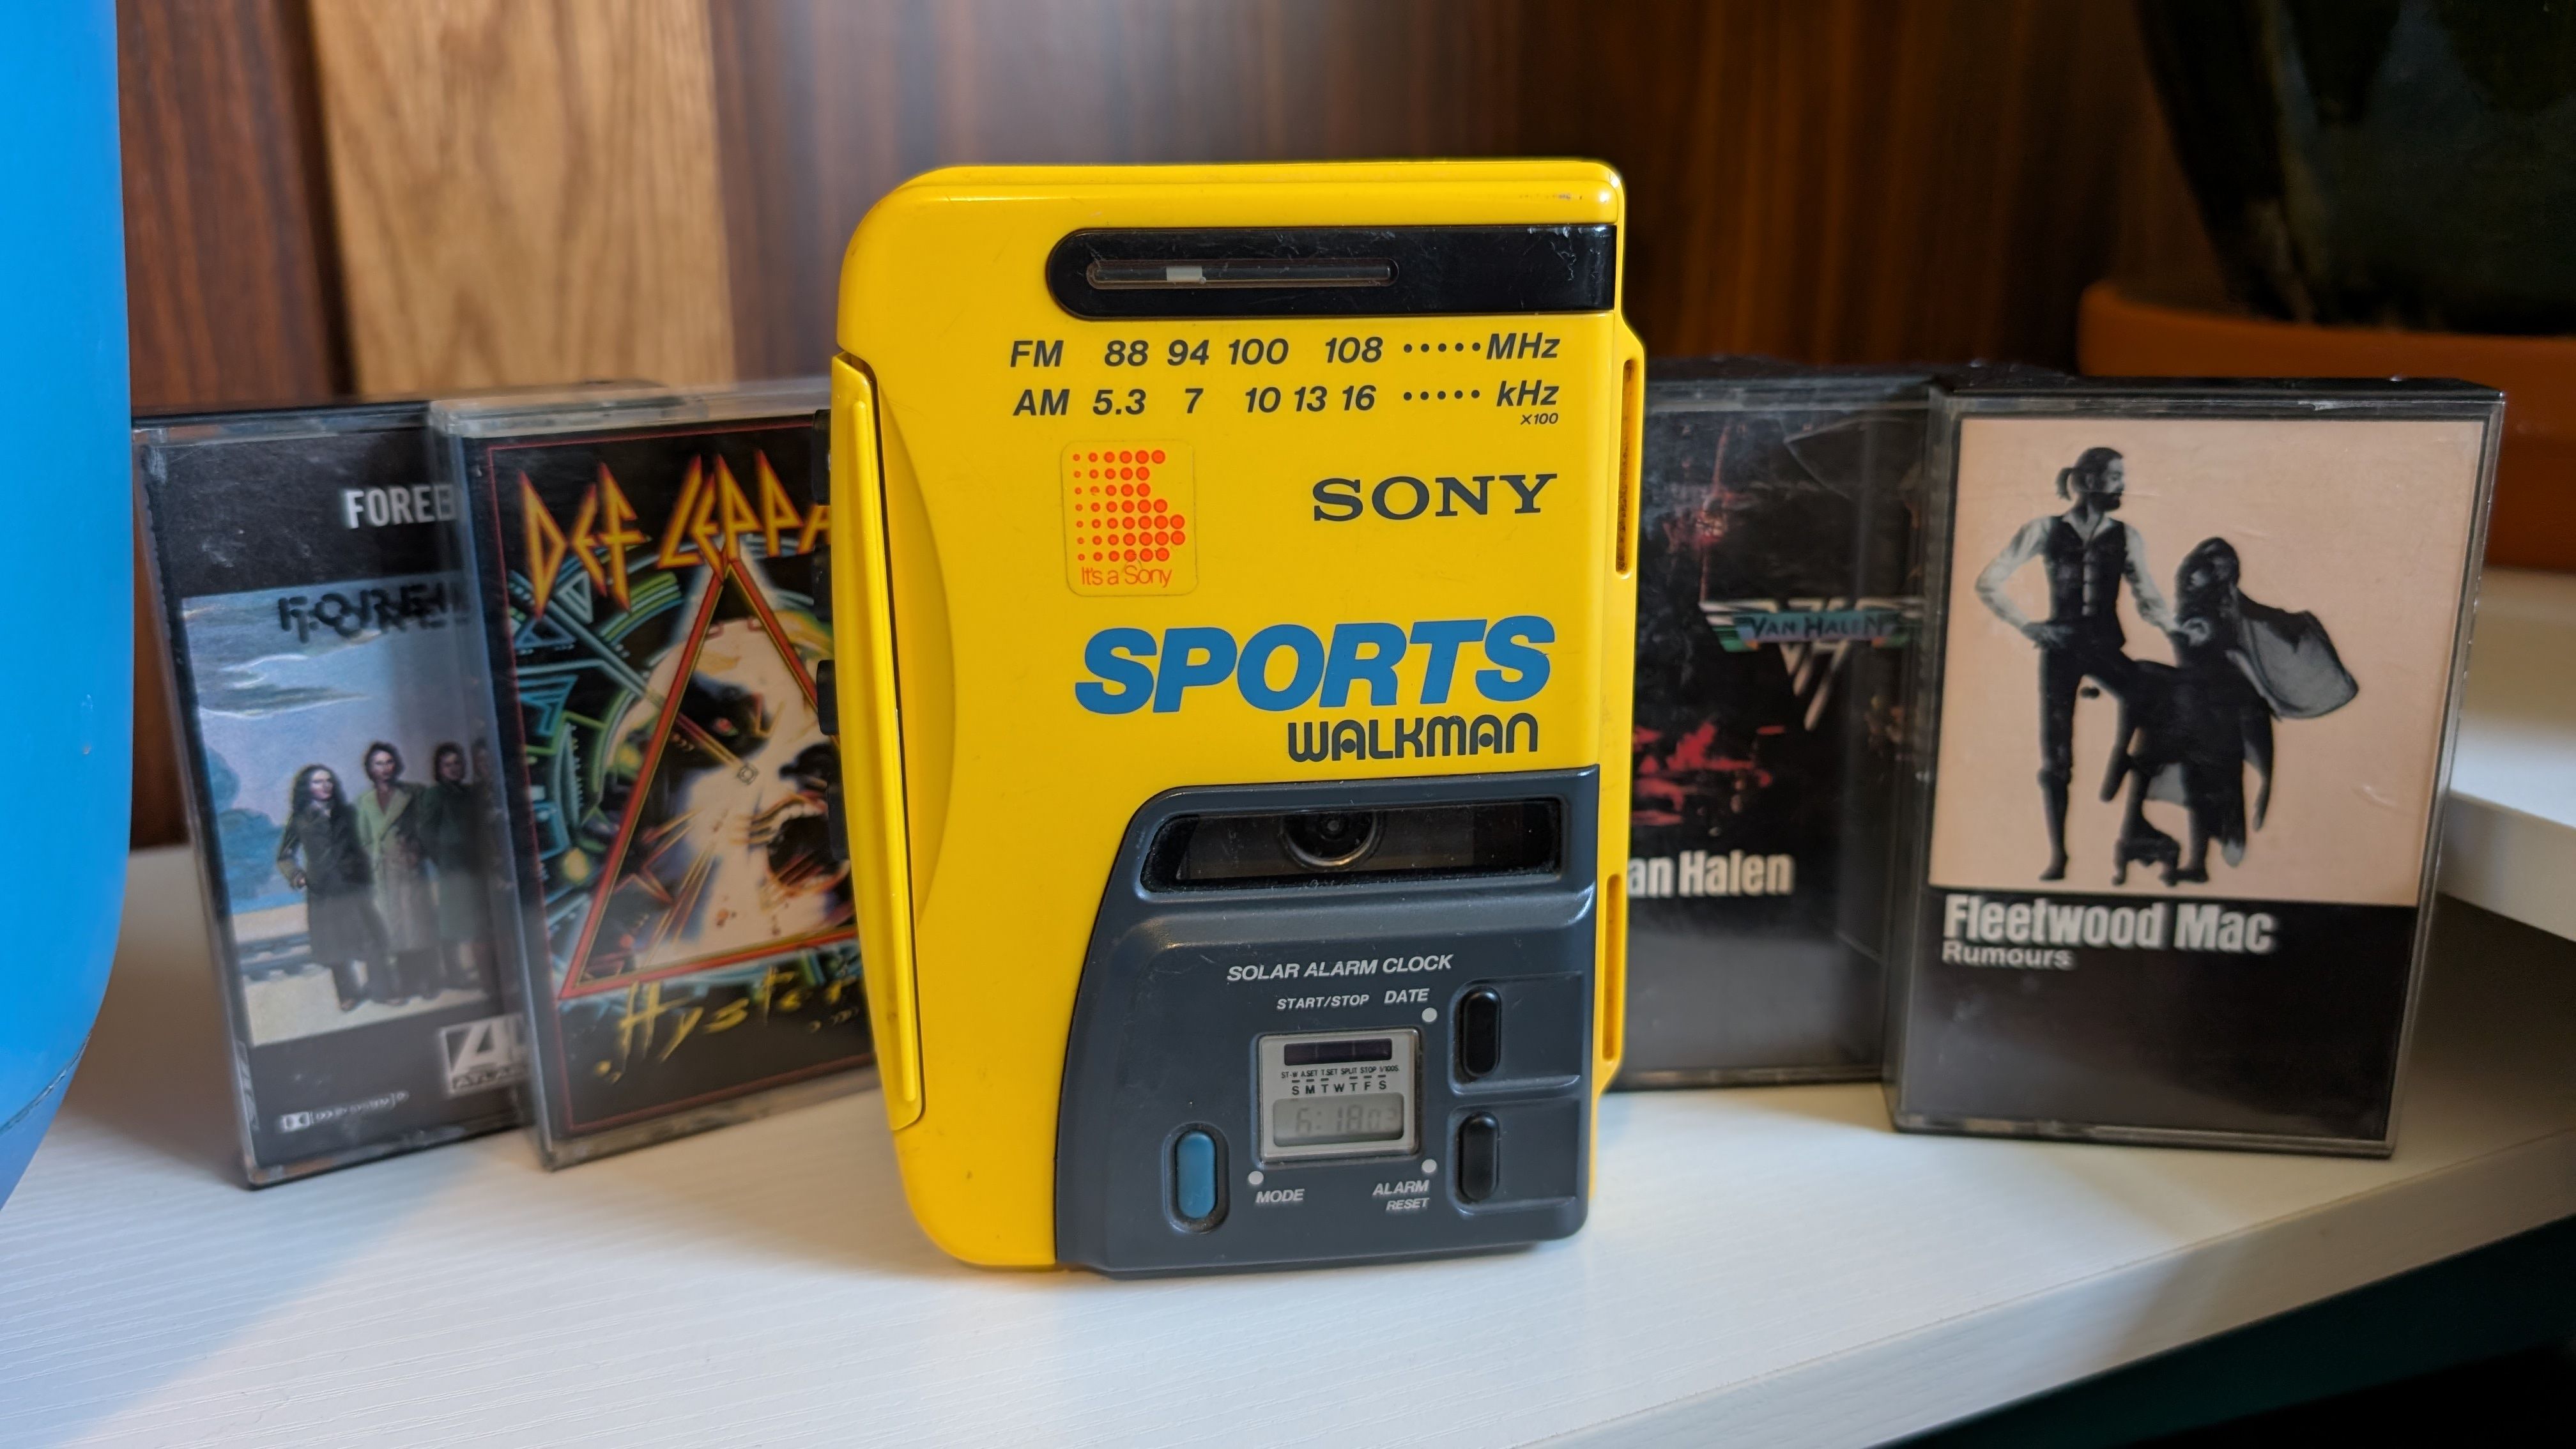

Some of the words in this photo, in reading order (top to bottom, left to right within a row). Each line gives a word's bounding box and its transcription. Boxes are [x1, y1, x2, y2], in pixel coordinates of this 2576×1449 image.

[1010, 340, 1064, 368] FM
[1104, 340, 1149, 367] 88
[1167, 339, 1210, 366] 94
[1229, 338, 1289, 365] 100
[1325, 336, 1384, 364] 108
[1486, 332, 1561, 360] MHz
[1013, 388, 1070, 416] AM
[1092, 388, 1147, 415] 5.3
[1184, 388, 1204, 414] 7
[1245, 386, 1282, 413] 10
[1294, 386, 1328, 412] 13
[1342, 385, 1377, 411] 16
[1496, 379, 1560, 407] kHz
[1312, 473, 1558, 522] SONY
[518, 461, 648, 620] DEF
[1082, 566, 1104, 585] It's
[1107, 569, 1119, 585] a
[1124, 564, 1173, 588] Sony
[1075, 615, 1556, 715] SPORTS
[1287, 712, 1539, 763] WALKMAN
[1678, 850, 1793, 896] Halen
[1942, 893, 2168, 949] Fleetwood
[2174, 902, 2280, 953] Mac
[1227, 963, 1300, 981] SOLAR
[1303, 959, 1378, 977] ALARM
[1383, 954, 1453, 973] CLOCK
[1942, 939, 2077, 970] Rumours
[1277, 994, 1370, 1009] START/STOP
[1384, 988, 1430, 1004] DATE
[1292, 1085, 1300, 1095] S
[1305, 1085, 1315, 1094] M
[1321, 1084, 1329, 1093] T
[1333, 1083, 1345, 1092] W
[1349, 1082, 1358, 1091] T
[1364, 1081, 1371, 1091] F
[1379, 1080, 1387, 1090] S
[1255, 1188, 1305, 1203] MODE
[1372, 1180, 1429, 1196] ALARM
[1385, 1198, 1429, 1211] RESET
